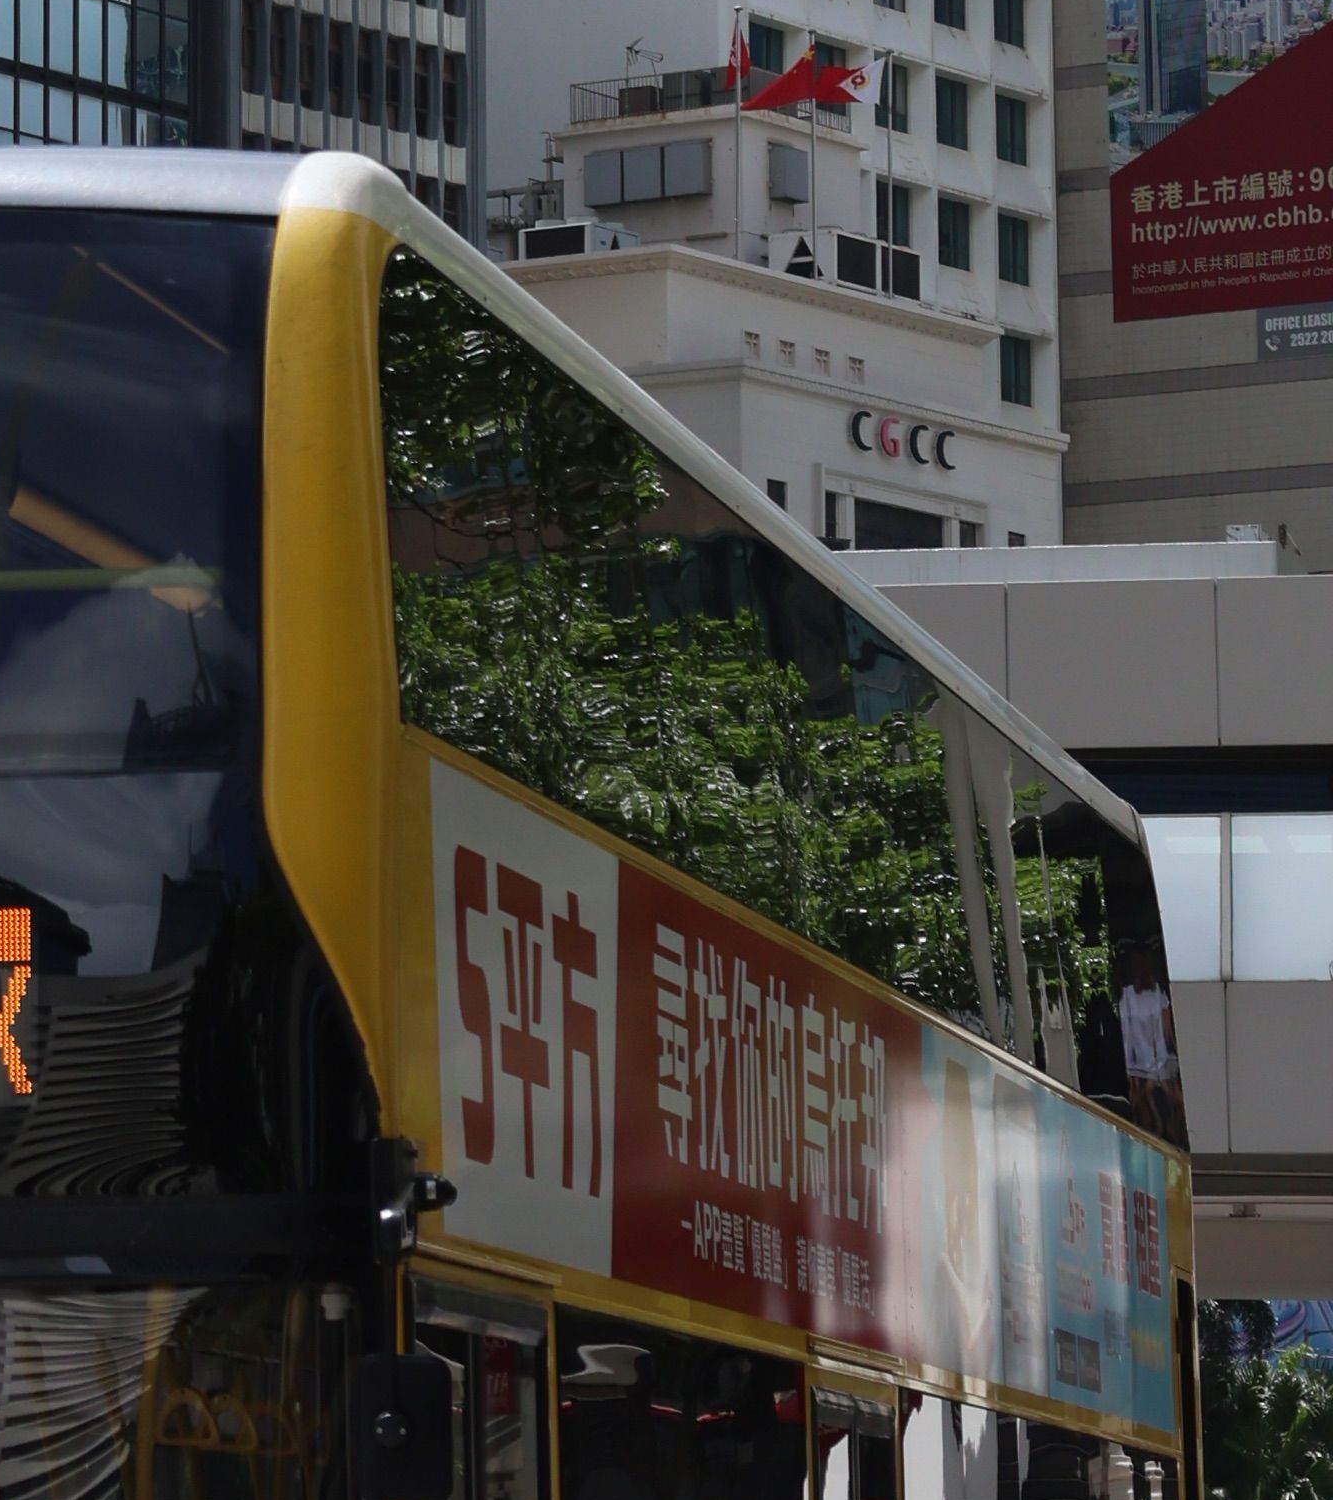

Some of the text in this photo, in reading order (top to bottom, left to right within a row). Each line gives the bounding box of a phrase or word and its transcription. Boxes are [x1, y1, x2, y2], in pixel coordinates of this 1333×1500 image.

[1130, 203, 1333, 244] http://www.cbhb.
[1132, 280, 1189, 296] Incorporated
[1201, 277, 1216, 289] the
[1218, 274, 1257, 290] People's
[1259, 270, 1300, 285] Republic
[1302, 268, 1312, 280] of
[1265, 315, 1301, 333] OFFICE
[1289, 331, 1319, 348] 2522
[849, 410, 957, 472] CGCC
